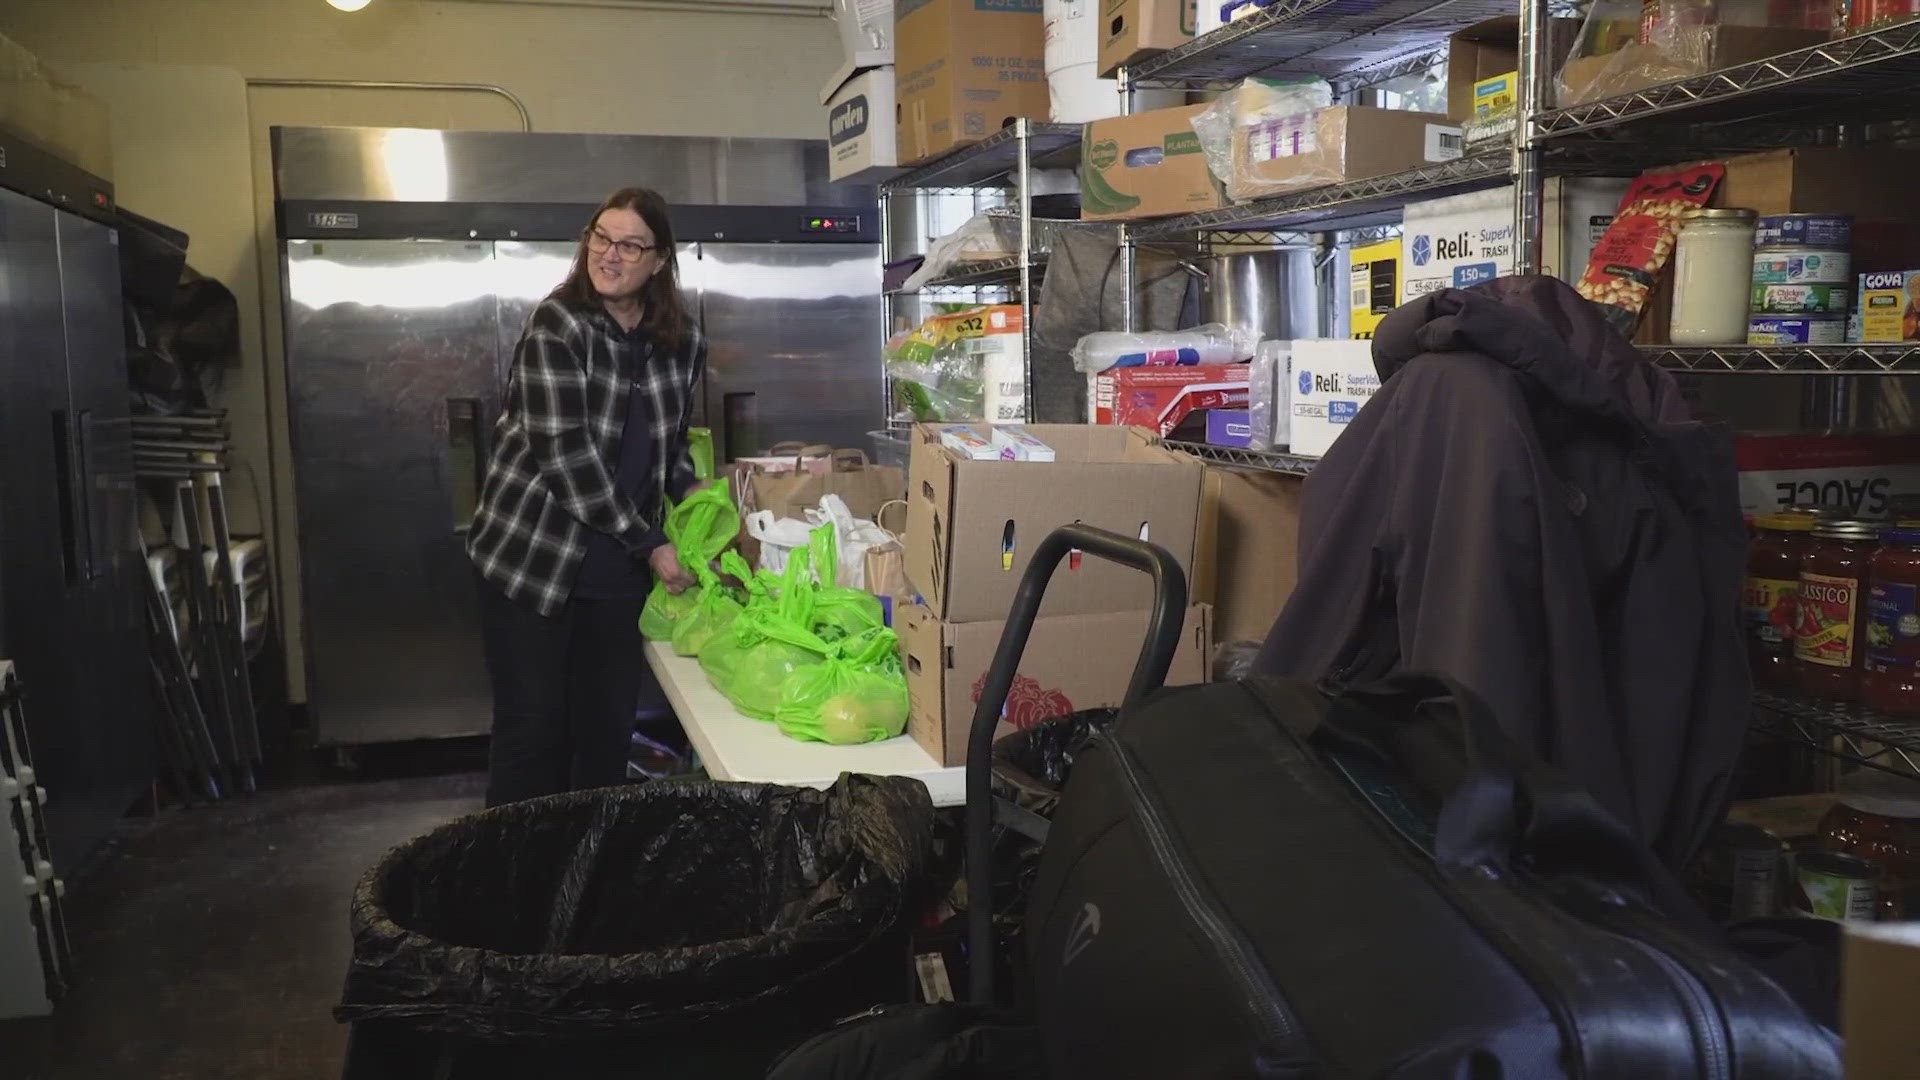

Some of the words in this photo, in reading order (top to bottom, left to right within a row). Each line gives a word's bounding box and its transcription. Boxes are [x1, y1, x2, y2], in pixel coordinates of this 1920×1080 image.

[1167, 140, 1199, 151] PLANTA
[1480, 225, 1514, 243] SuperV
[1436, 231, 1473, 261] Reli.
[1481, 245, 1509, 258] TRASH
[1461, 267, 1479, 282] 150
[1866, 273, 1902, 289] GOYA
[1315, 373, 1342, 392] Reli.
[1347, 387, 1366, 396] TRASH
[1333, 403, 1346, 413] 150
[1776, 478, 1891, 515] SAUCE
[1803, 584, 1849, 604] ASSICO
